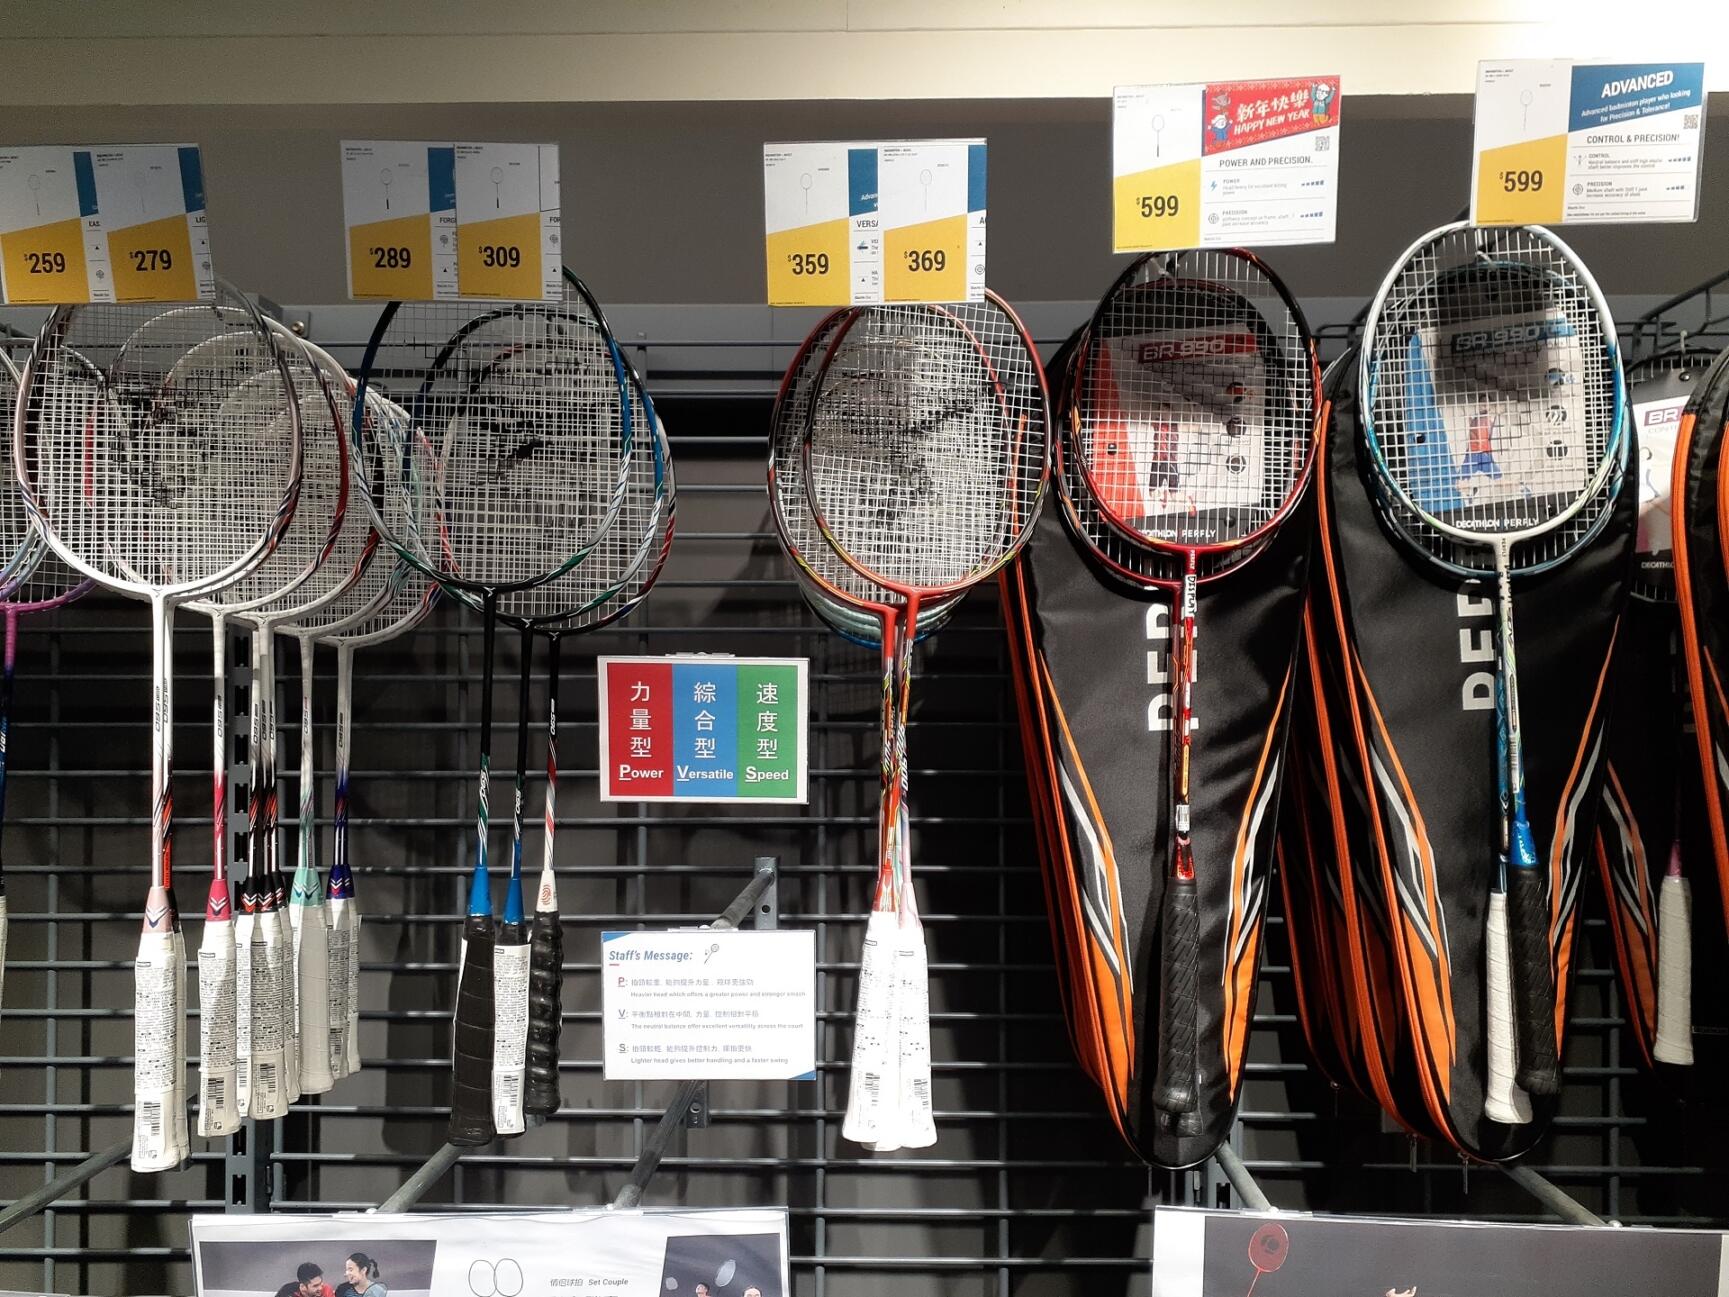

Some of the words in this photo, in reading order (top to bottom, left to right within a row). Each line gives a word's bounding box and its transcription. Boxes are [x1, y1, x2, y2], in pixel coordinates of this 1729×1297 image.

[1601, 70, 1673, 98] ADVANCED
[1237, 89, 1309, 122] 新年快樂
[1234, 120, 1264, 135] HAPPY
[1266, 115, 1285, 127] NEW
[1287, 109, 1310, 122] YEAR
[1586, 134, 1625, 144] CONTROL
[1626, 135, 1632, 143] &
[1634, 133, 1680, 143] PRECISION!
[1219, 159, 1248, 168] POWER
[1250, 158, 1267, 166] AND
[1499, 170, 1543, 193] $599
[1136, 195, 1179, 218] $599
[24, 252, 65, 273] $259
[129, 249, 172, 271] $279
[369, 247, 411, 268] $289
[478, 246, 520, 268] $309
[788, 253, 829, 275] $359
[903, 250, 946, 272] $369
[1648, 408, 1678, 425] BR
[1182, 529, 1216, 537] PERFLY
[1456, 519, 1500, 528] DECATHLON
[1503, 518, 1539, 527] PERFLY
[1187, 576, 1196, 614] DISPLAY
[1144, 586, 1199, 731] PER
[629, 681, 652, 758] 力量型
[693, 681, 716, 759] 綜合型
[756, 682, 779, 759] 速度型
[619, 765, 664, 780] Power
[677, 765, 733, 781] Versatile
[745, 766, 789, 782] Speed
[901, 757, 909, 791] 900
[609, 950, 641, 961] Staff's
[643, 951, 693, 963] Message:
[602, 1278, 628, 1286] Couple
